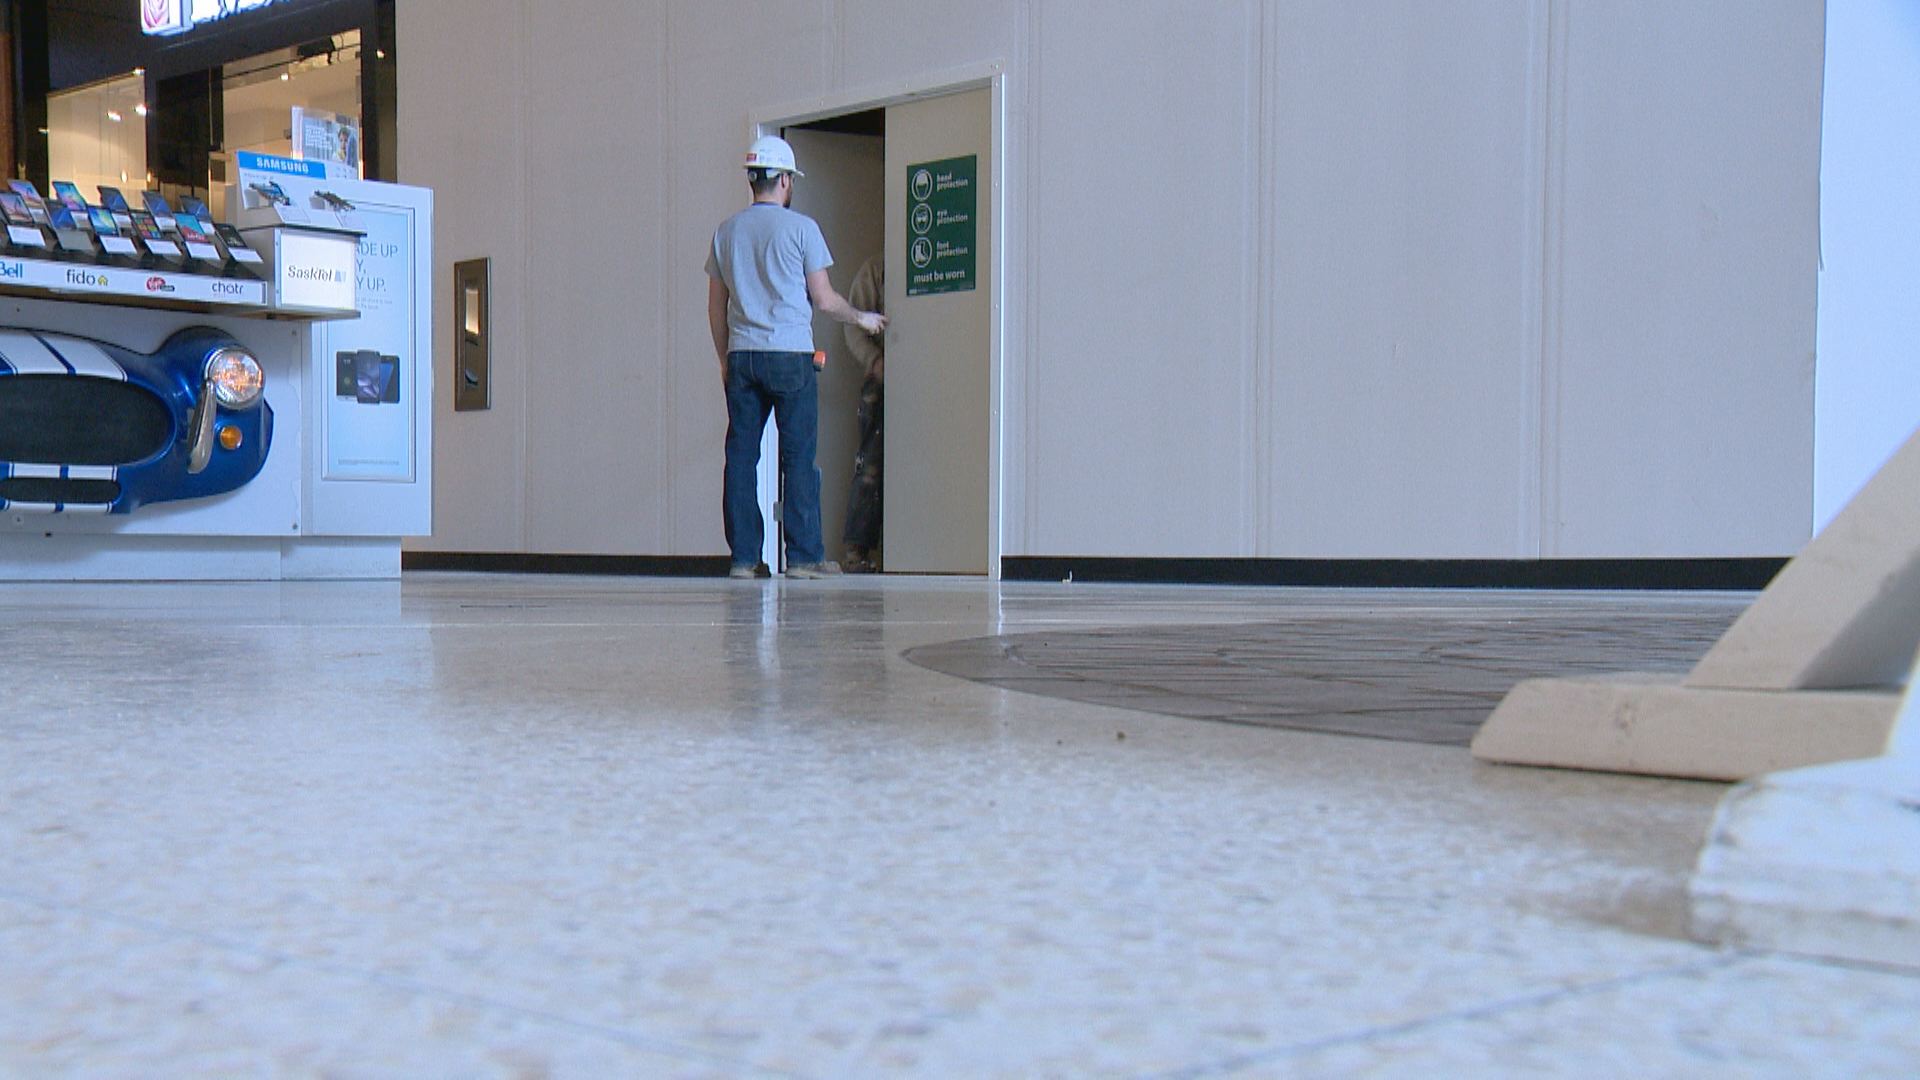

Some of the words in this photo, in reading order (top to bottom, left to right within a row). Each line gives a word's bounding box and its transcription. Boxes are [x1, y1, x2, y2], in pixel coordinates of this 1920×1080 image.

[256, 157, 309, 174] SAMSUNG
[937, 172, 952, 182] head
[937, 178, 968, 192] protection
[937, 209, 948, 219] eye
[937, 214, 968, 227] protection
[380, 243, 398, 258] UP
[937, 241, 949, 251] foot
[937, 247, 968, 259] protection
[0, 261, 23, 278] Bell
[288, 265, 332, 282] SaskTel
[66, 269, 96, 285] fido
[914, 272, 933, 284] must
[934, 270, 944, 281] be
[945, 270, 966, 280] worn
[211, 281, 244, 295] chatr
